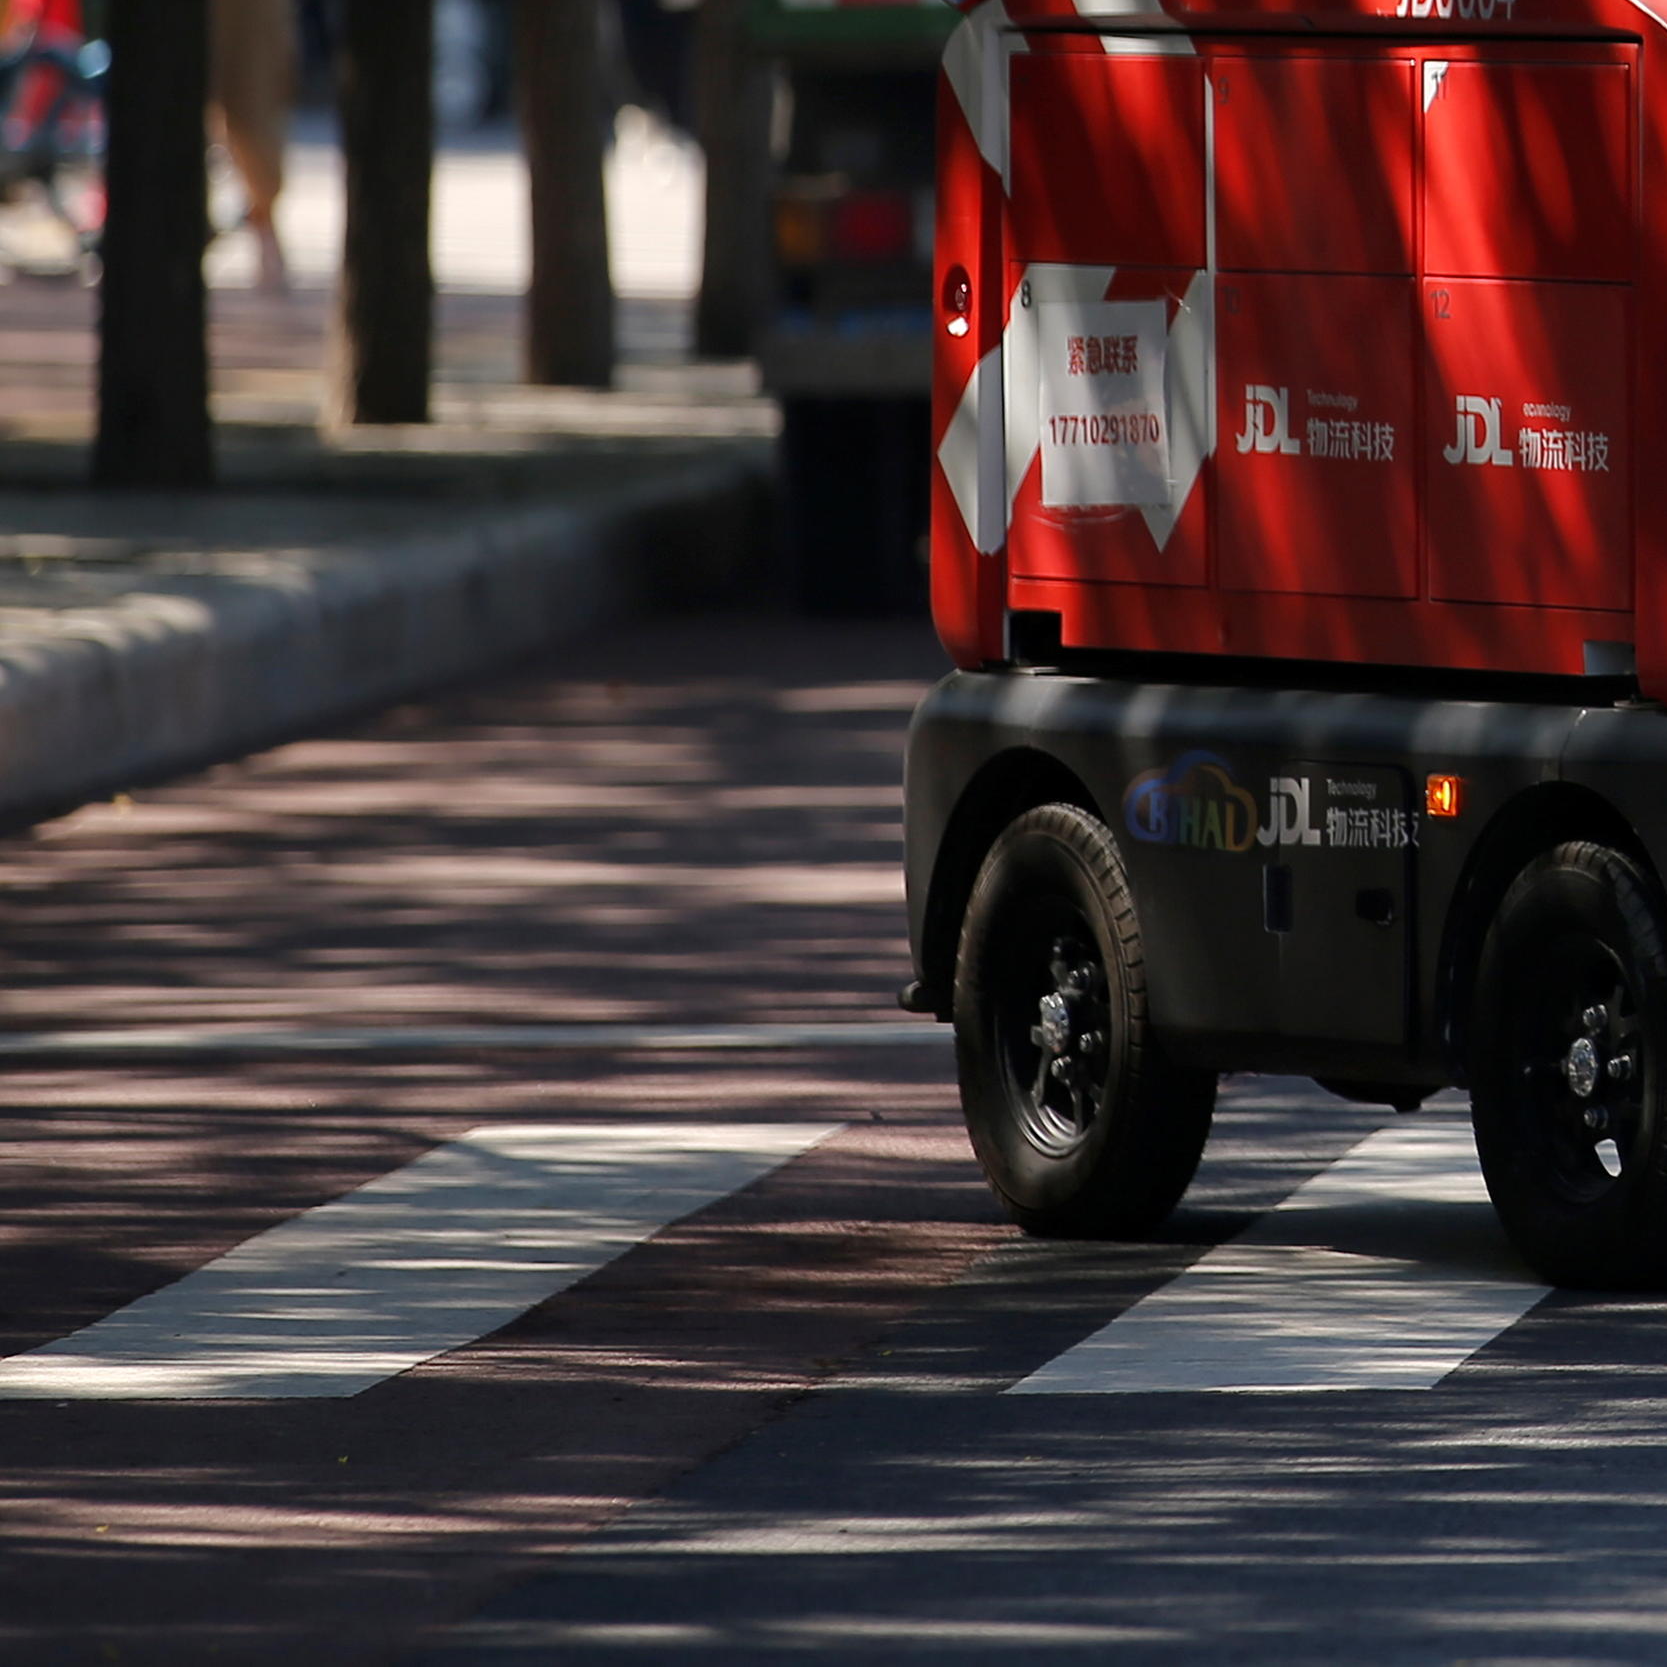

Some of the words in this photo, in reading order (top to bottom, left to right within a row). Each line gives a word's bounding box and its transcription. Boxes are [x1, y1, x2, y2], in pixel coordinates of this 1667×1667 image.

[1020, 280, 1032, 309] 8
[1430, 289, 1451, 319] 12
[1068, 336, 1138, 375] 紧急联系
[1049, 412, 1160, 446] 17710291870
[1235, 384, 1300, 455] JDL
[1306, 417, 1396, 461] 物流科技
[1443, 395, 1514, 466] JDL
[1519, 427, 1610, 473] 物流科技
[1256, 777, 1321, 846] JDL
[1326, 807, 1420, 849] 物流科技
